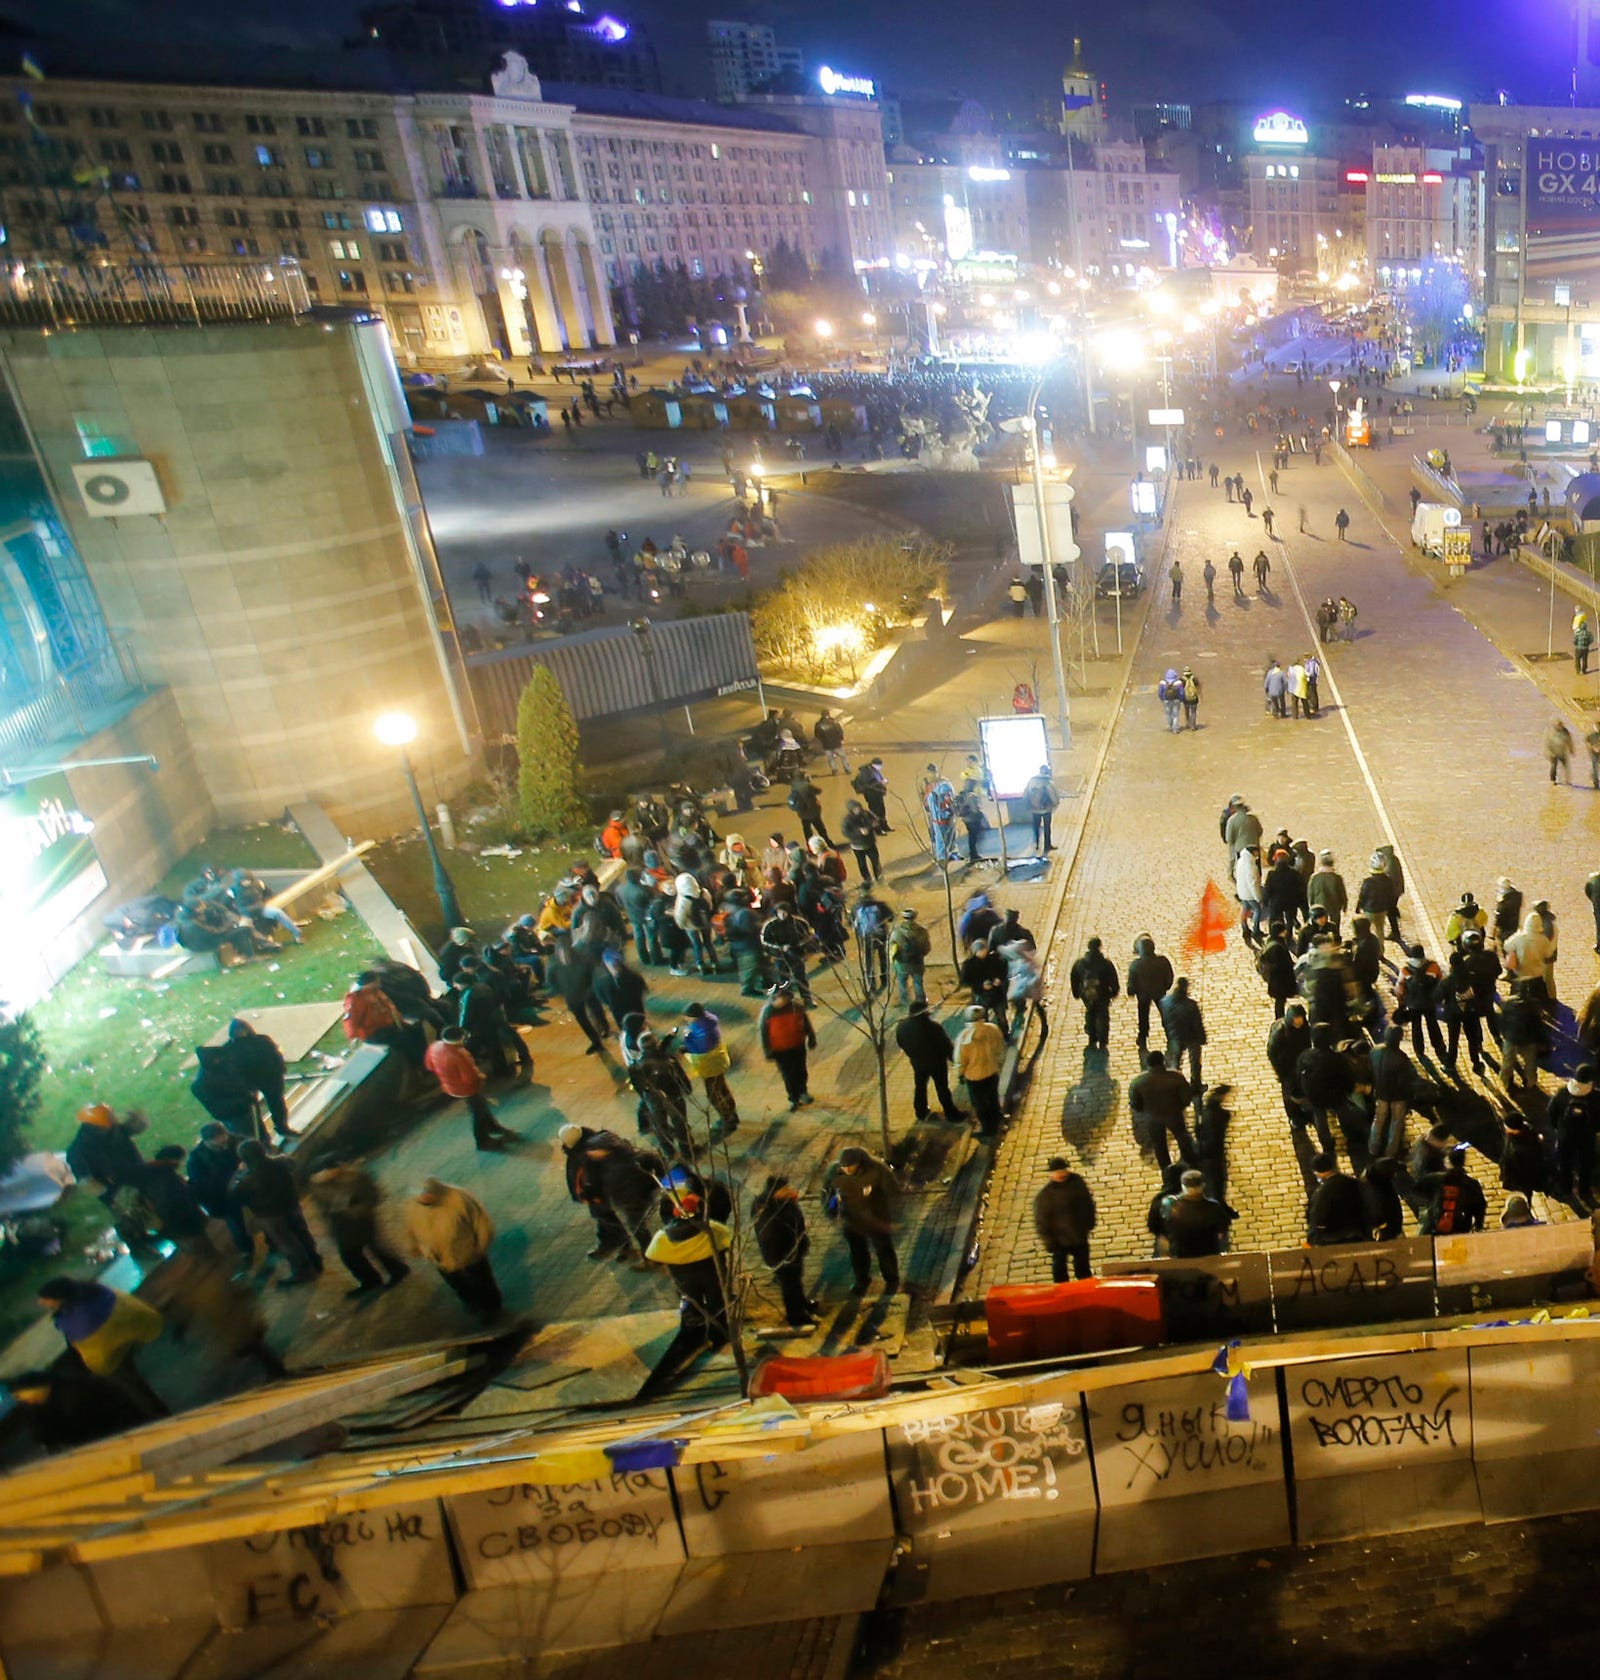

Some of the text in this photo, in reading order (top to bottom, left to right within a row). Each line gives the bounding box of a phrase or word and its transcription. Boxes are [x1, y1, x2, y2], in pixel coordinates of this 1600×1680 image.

[1538, 173, 1575, 194] GX
[1302, 1375, 1424, 1408] СМЕРТЬ
[909, 1456, 1060, 1514] HOME!
